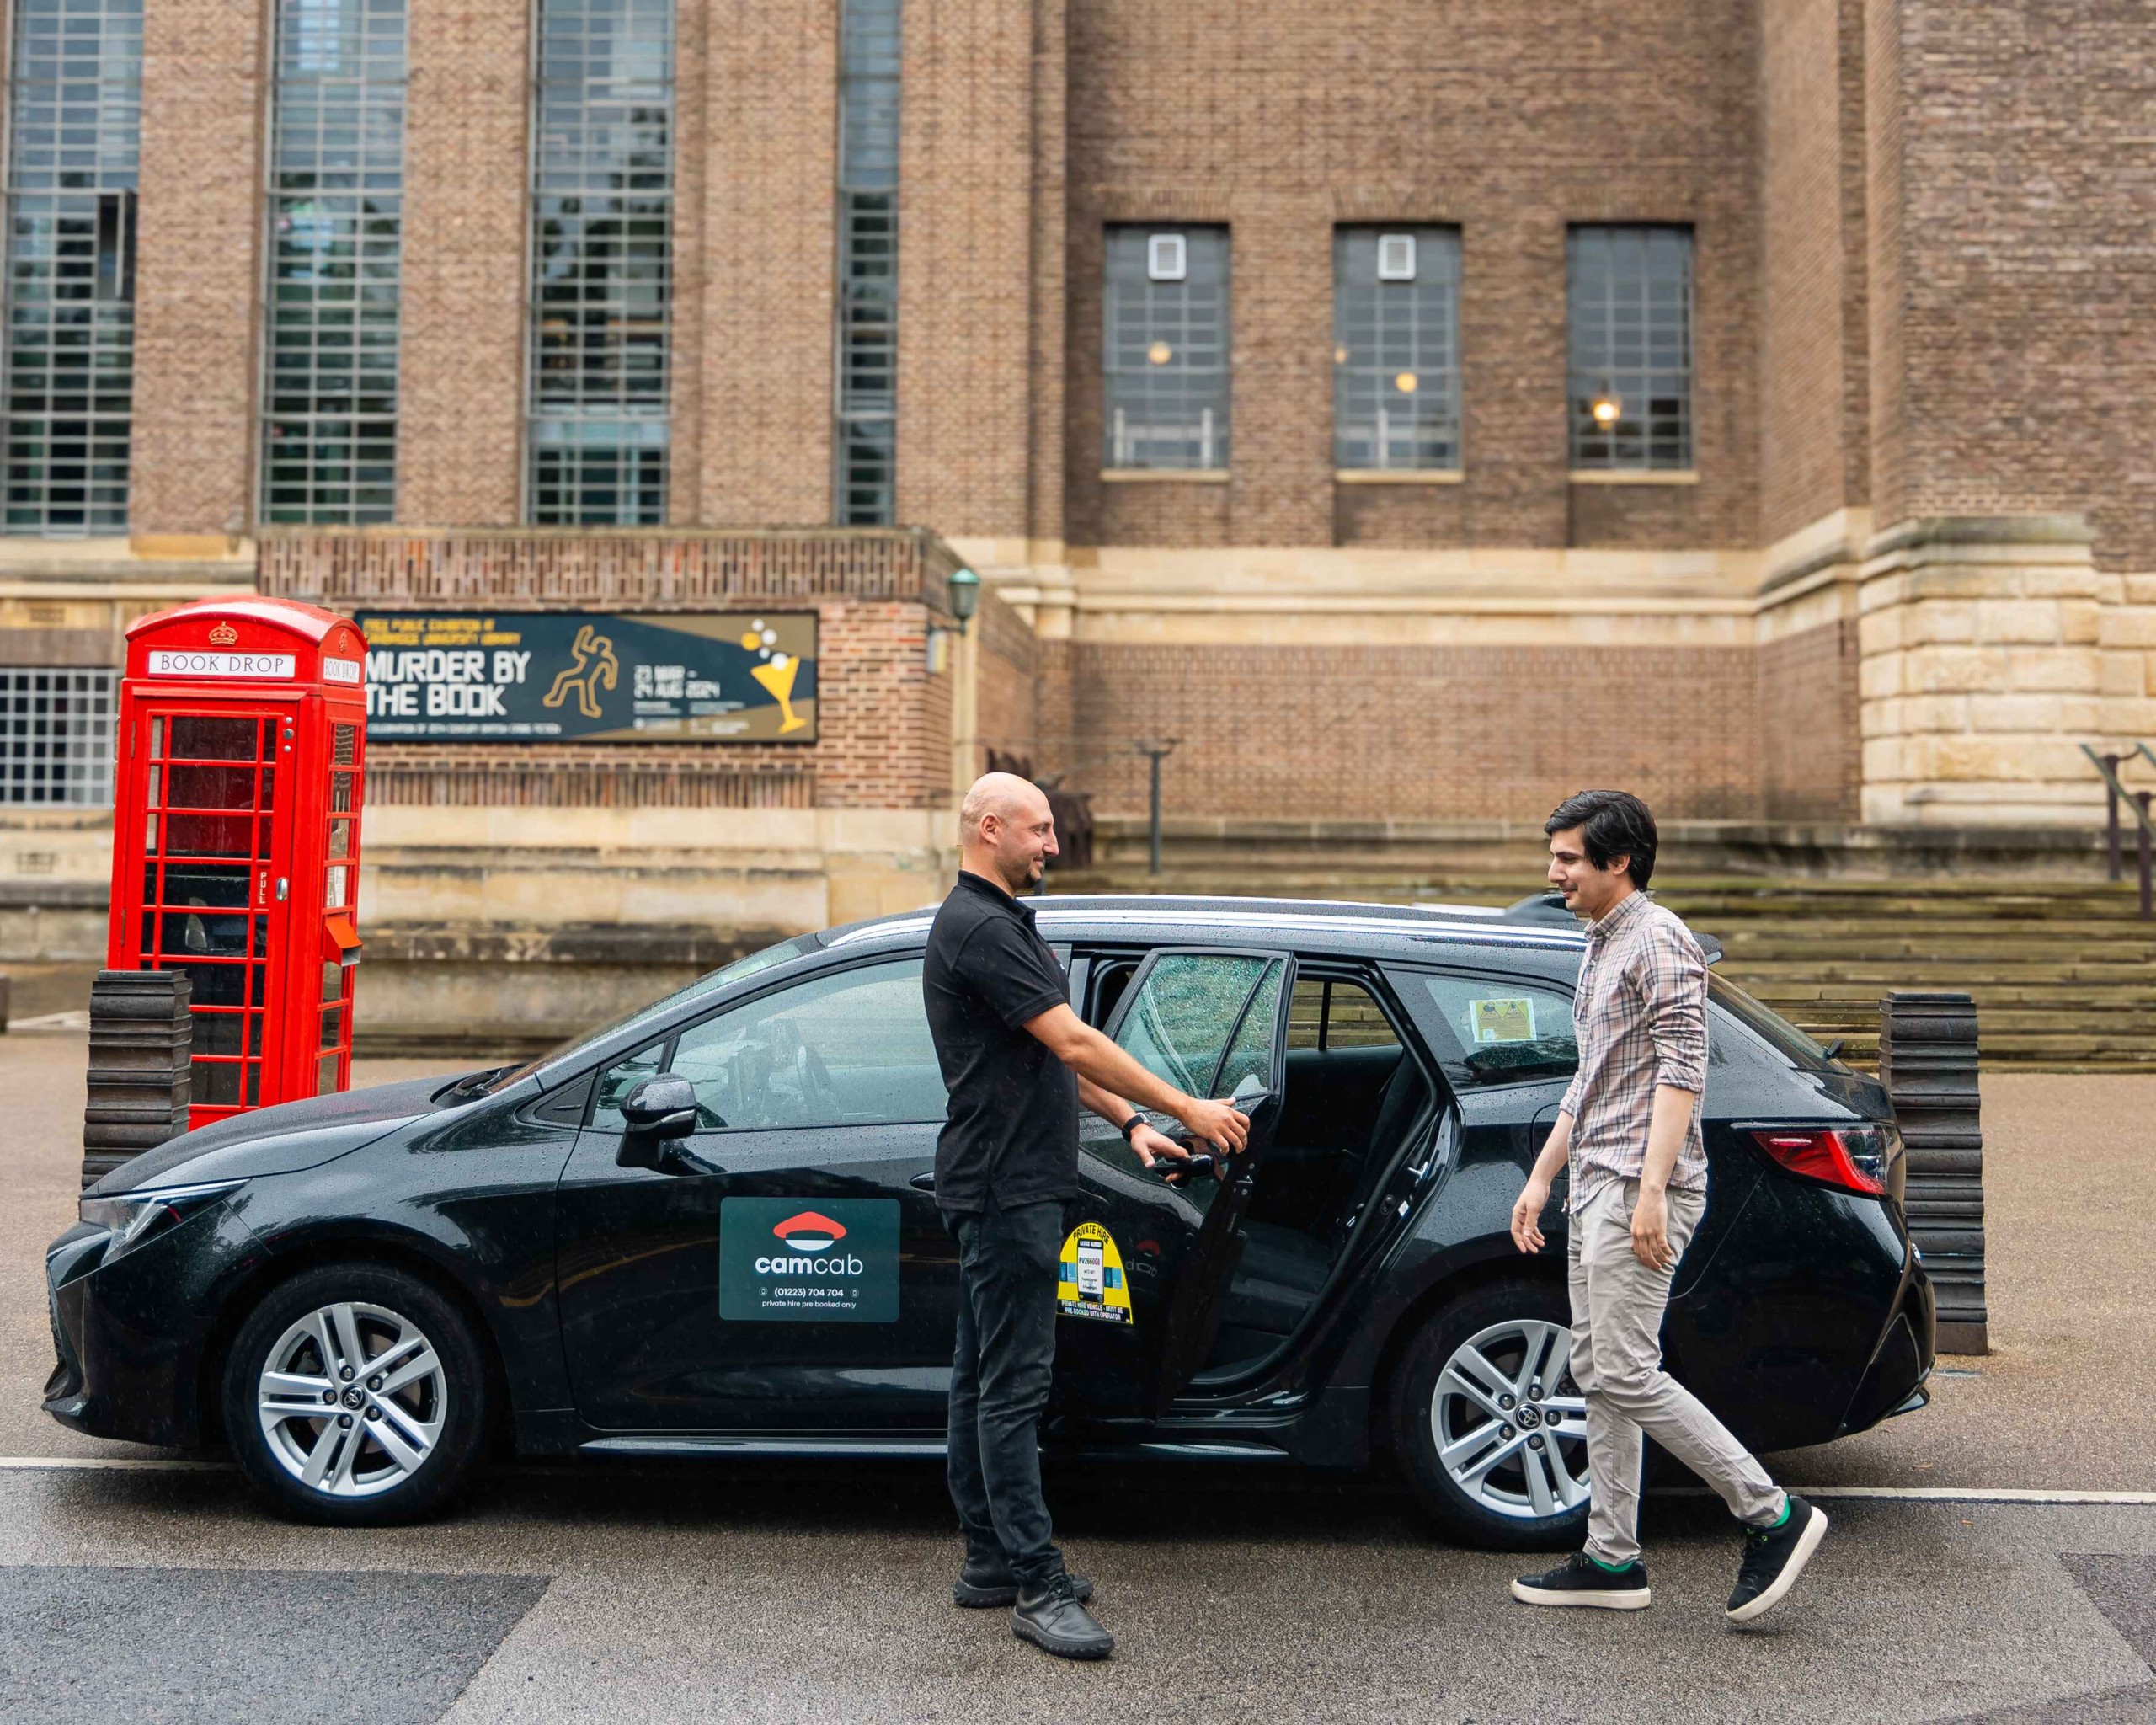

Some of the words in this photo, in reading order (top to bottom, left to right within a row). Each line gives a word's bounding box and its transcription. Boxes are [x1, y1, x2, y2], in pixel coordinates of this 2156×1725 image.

[161, 654, 220, 671] BOOK
[229, 656, 284, 673] DROP
[325, 660, 341, 676] BOOK
[341, 662, 356, 680] DROP
[365, 649, 485, 683] MURDER
[494, 650, 531, 684] BY
[364, 683, 419, 717] THE
[427, 683, 507, 717] BOOK
[259, 872, 267, 905] PULL
[1073, 1224, 1096, 1242] PRIVATE
[1097, 1226, 1110, 1246] HIRE
[755, 1253, 863, 1275] camcab
[774, 1287, 806, 1298] (01223)
[808, 1288, 825, 1297] 704
[827, 1288, 844, 1297] 704
